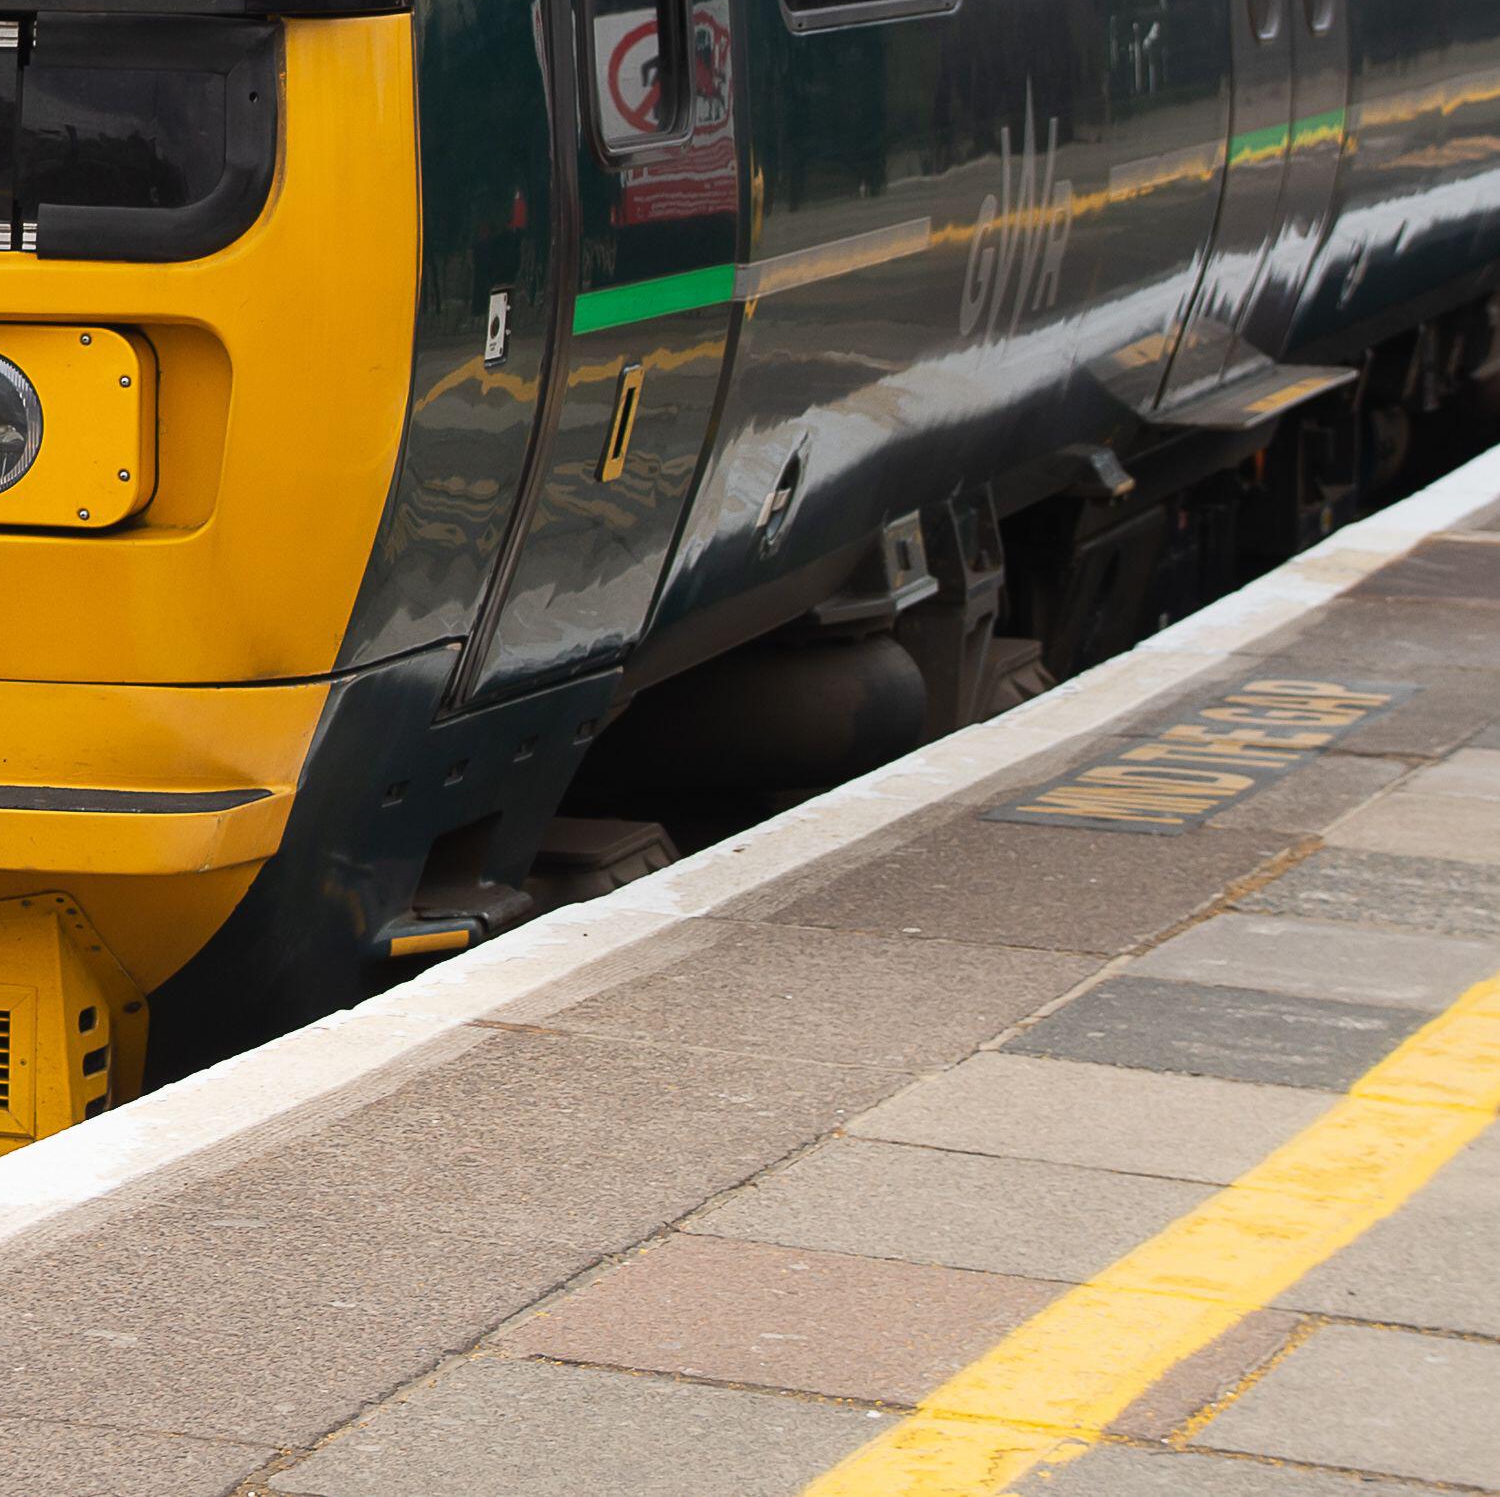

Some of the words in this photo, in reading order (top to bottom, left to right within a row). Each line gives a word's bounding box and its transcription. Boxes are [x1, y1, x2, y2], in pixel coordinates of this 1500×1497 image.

[960, 70, 1073, 348] GWR
[1199, 678, 1393, 727] GAP
[1118, 723, 1336, 769] THE
[1016, 765, 1256, 825] MIND
